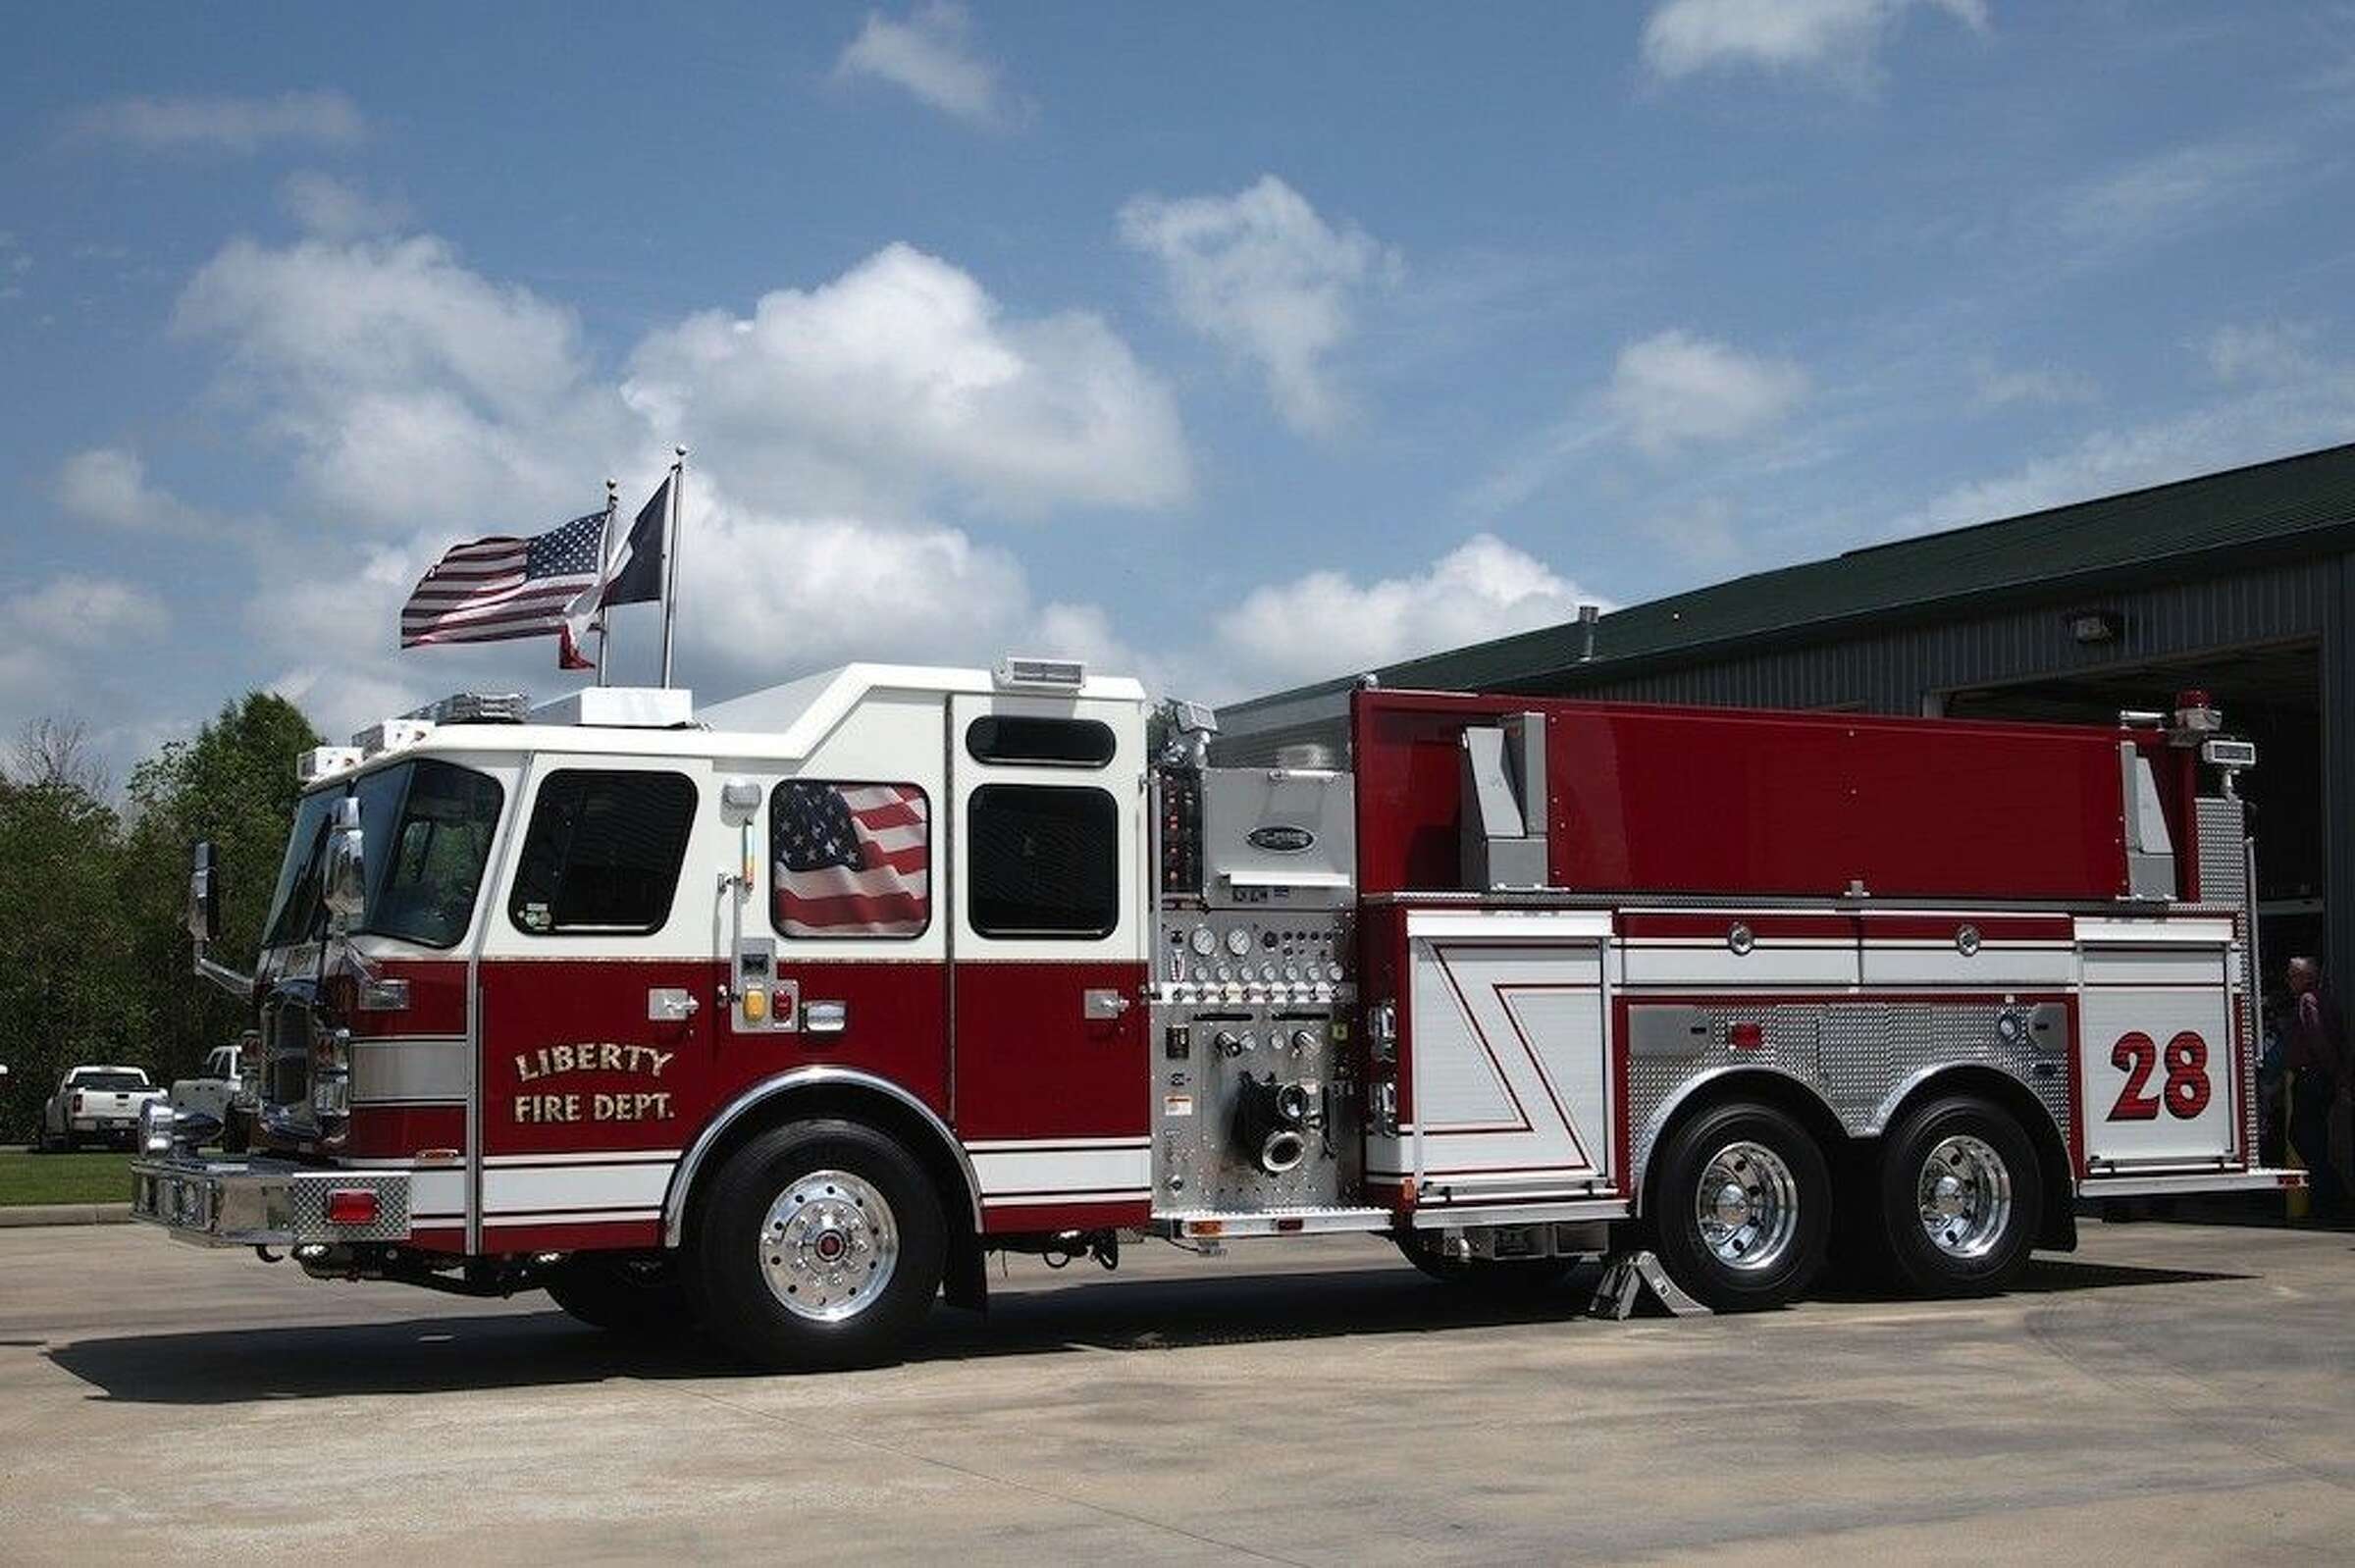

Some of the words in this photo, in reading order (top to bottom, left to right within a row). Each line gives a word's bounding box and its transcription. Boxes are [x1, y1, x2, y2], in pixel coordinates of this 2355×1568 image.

[515, 1043, 674, 1081] LIBERTY
[2105, 1031, 2211, 1122] 28
[515, 1094, 582, 1123] FIRE
[594, 1092, 675, 1121] DEPT.
